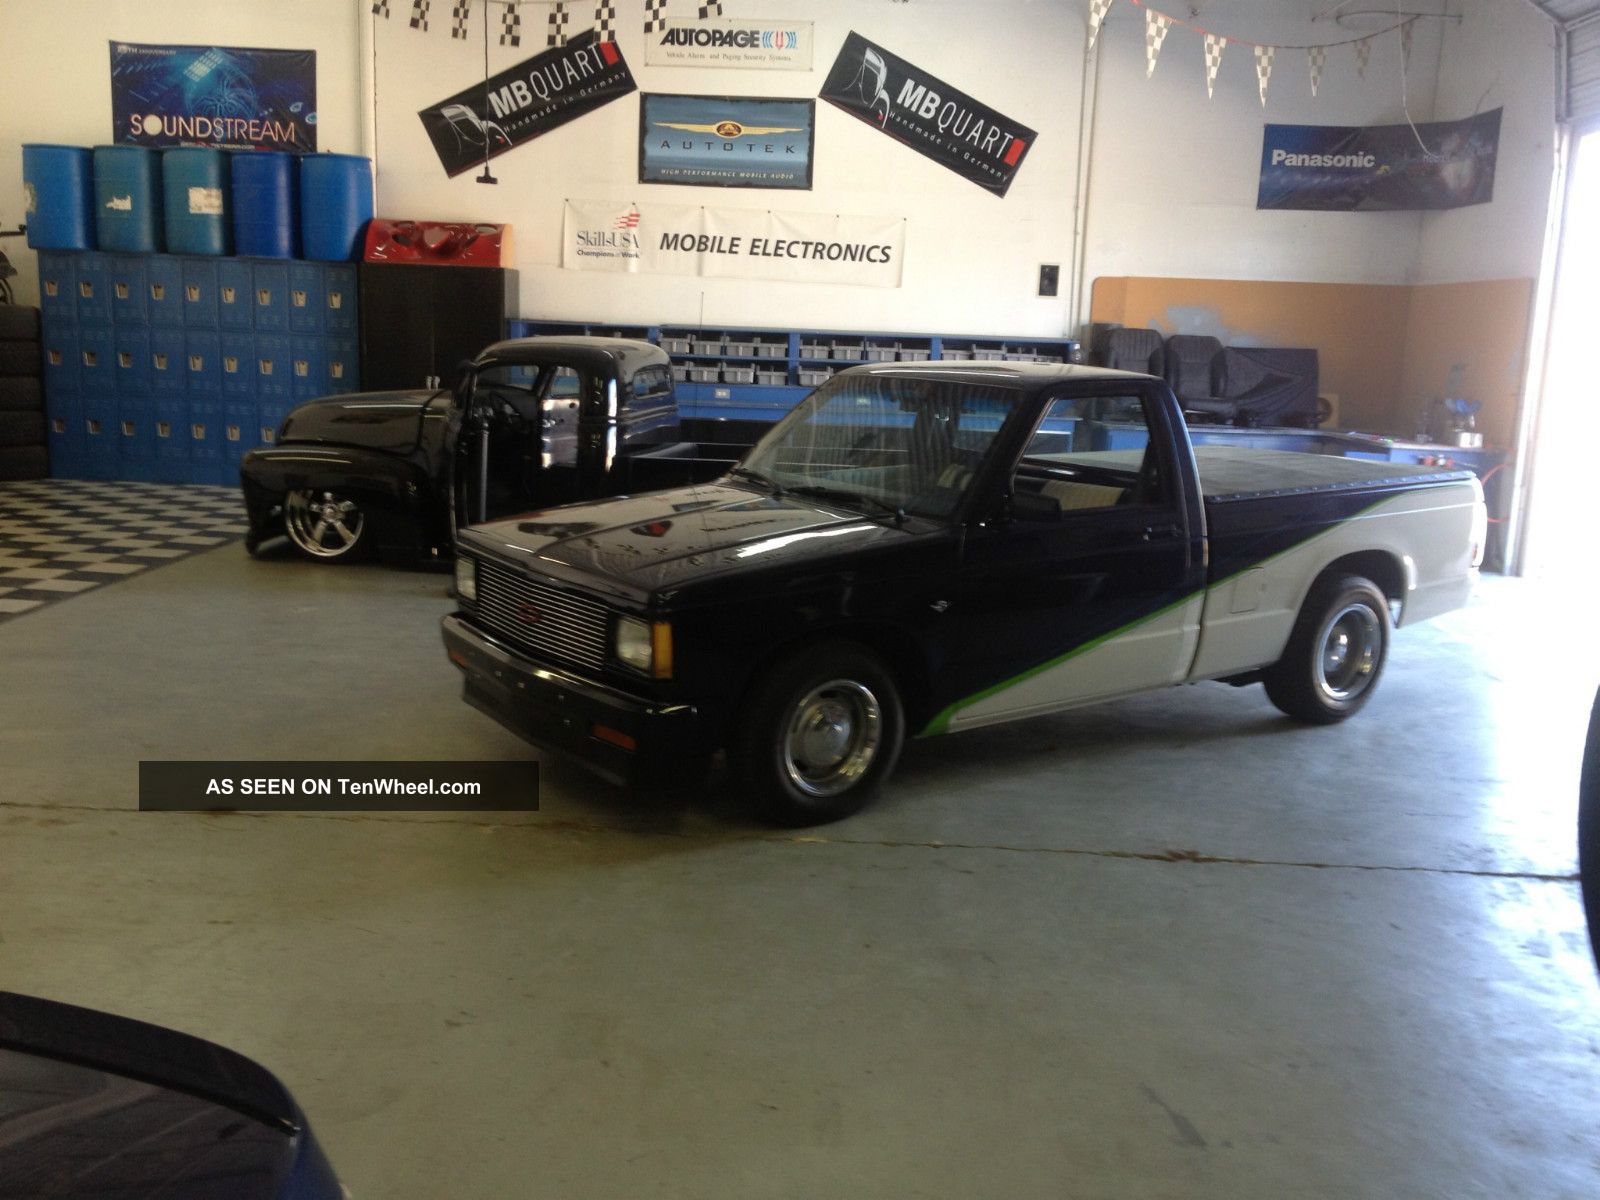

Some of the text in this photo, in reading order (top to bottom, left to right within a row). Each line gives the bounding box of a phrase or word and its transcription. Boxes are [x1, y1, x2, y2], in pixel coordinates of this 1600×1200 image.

[660, 28, 760, 48] AUTOPAGE
[503, 103, 557, 132] Handmade
[580, 71, 627, 97] Germany
[131, 113, 296, 143] SOUNDSTREAM
[660, 140, 795, 153] AUTOTEK
[889, 110, 1009, 182] Handmade in Germany
[1271, 149, 1376, 168] Panasonic
[682, 169, 736, 178] PERFORMANCE
[659, 232, 892, 264] MOBILE ELECTRONICS
